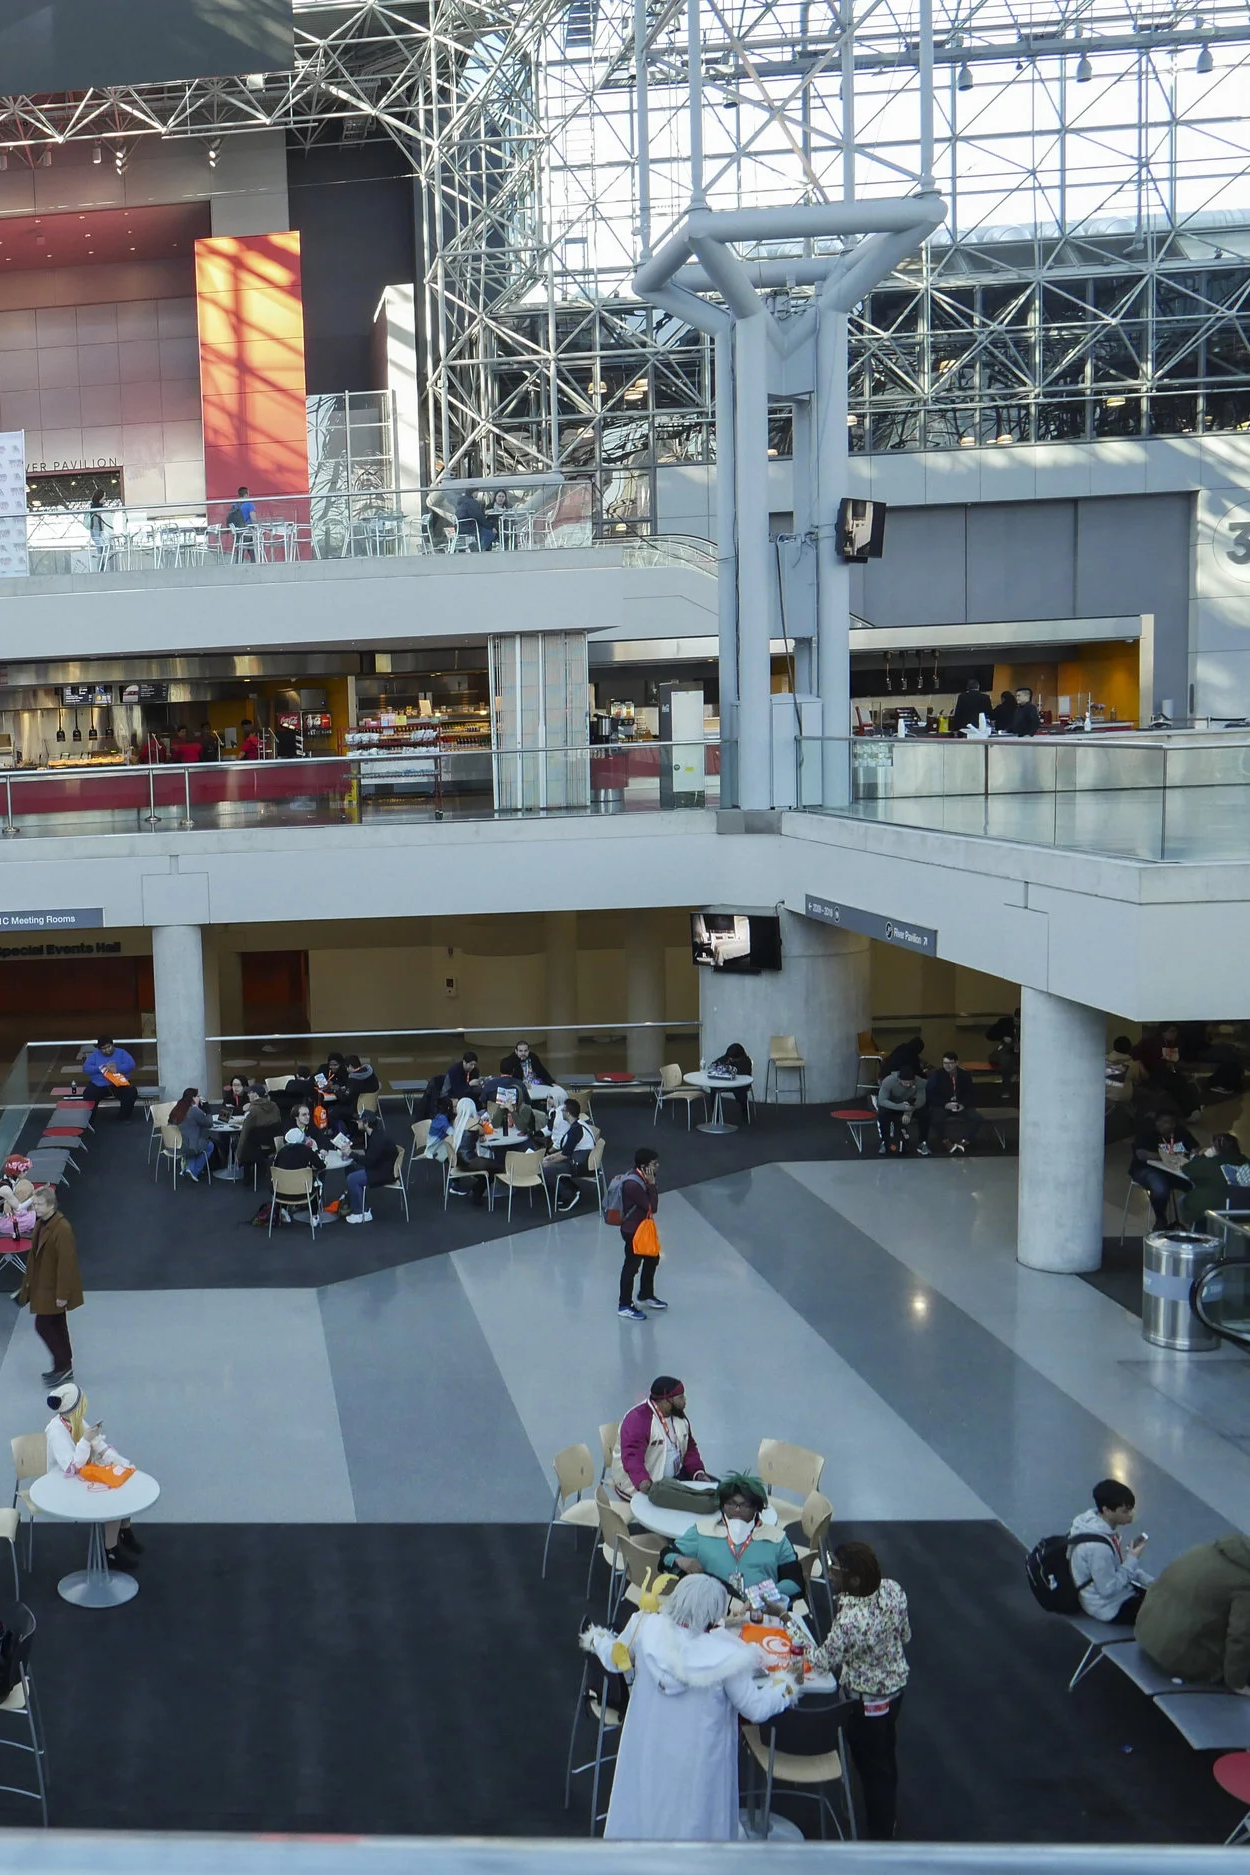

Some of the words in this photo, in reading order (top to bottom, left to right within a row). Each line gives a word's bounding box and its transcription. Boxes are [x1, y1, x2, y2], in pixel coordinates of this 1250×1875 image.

[53, 458, 117, 471] PAVILION
[11, 916, 44, 926] Meeting
[46, 915, 76, 924] Rooms
[45, 943, 94, 955] Events
[96, 942, 121, 953] Hall
